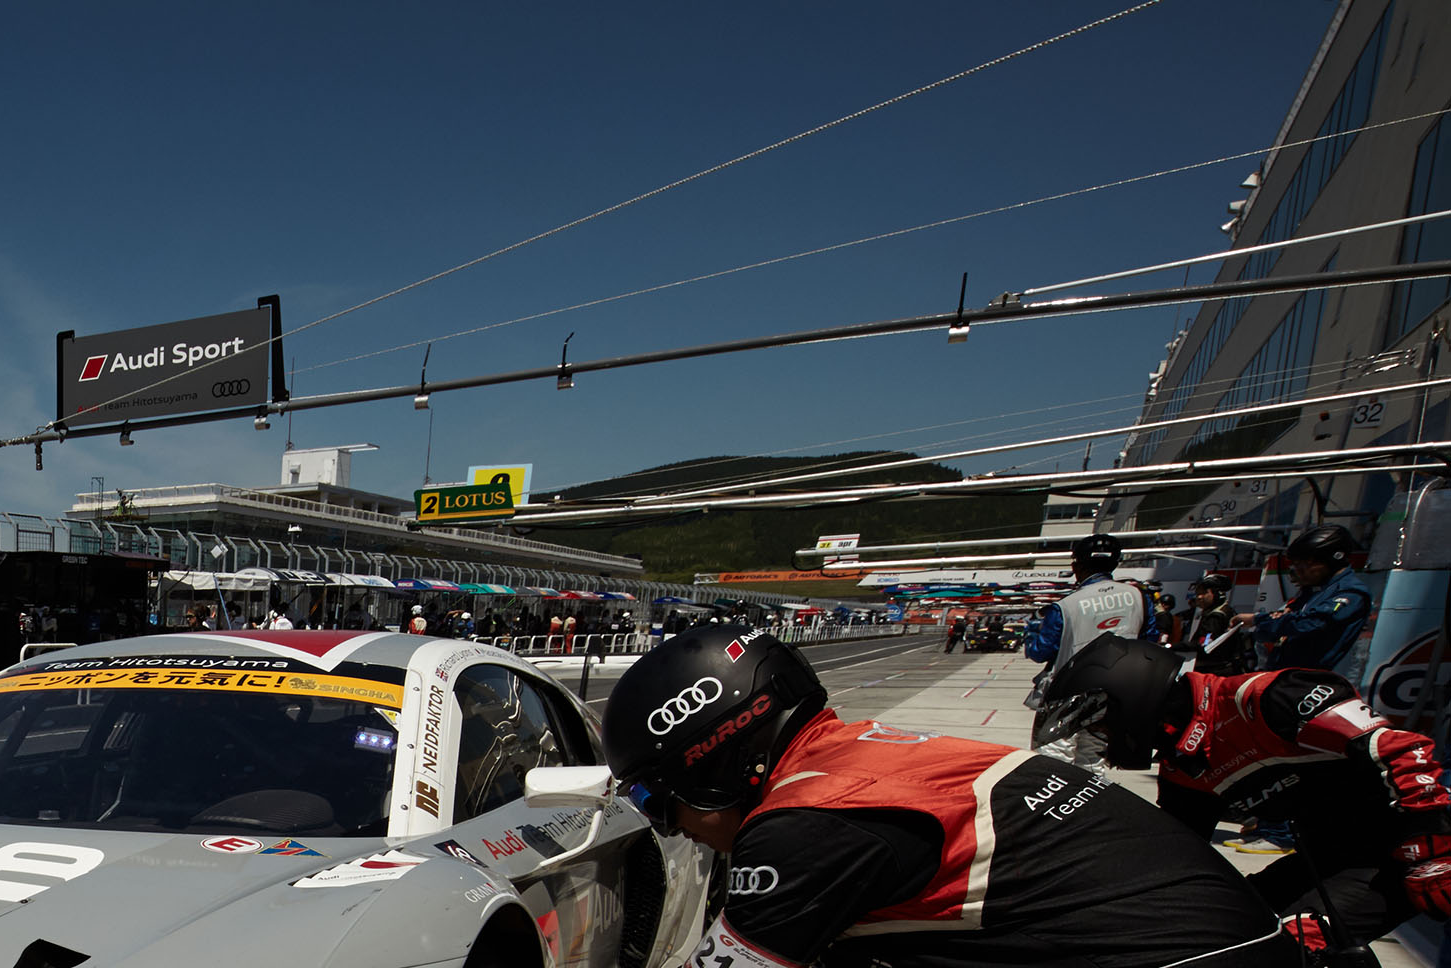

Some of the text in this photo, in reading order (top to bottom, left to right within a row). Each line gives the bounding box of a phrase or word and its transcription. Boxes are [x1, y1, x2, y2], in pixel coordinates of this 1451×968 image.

[110, 337, 245, 373] Audi Sport
[104, 401, 130, 412] Team
[132, 392, 198, 408] Hitotsuyama
[1353, 403, 1384, 425] 32
[1250, 479, 1268, 493] 31
[422, 490, 507, 514] 2 LOTUS
[838, 540, 853, 549] apr
[1079, 591, 1136, 616] PHOTO
[45, 660, 104, 671] Team
[108, 656, 289, 669] Hitotsuyama
[317, 683, 398, 702] SINGHA
[422, 685, 445, 774] NEIDFAKTOR
[684, 693, 774, 769] RuRoC
[1022, 774, 1070, 812] Audi
[1043, 782, 1097, 822] Team
[482, 830, 528, 860] Audi
